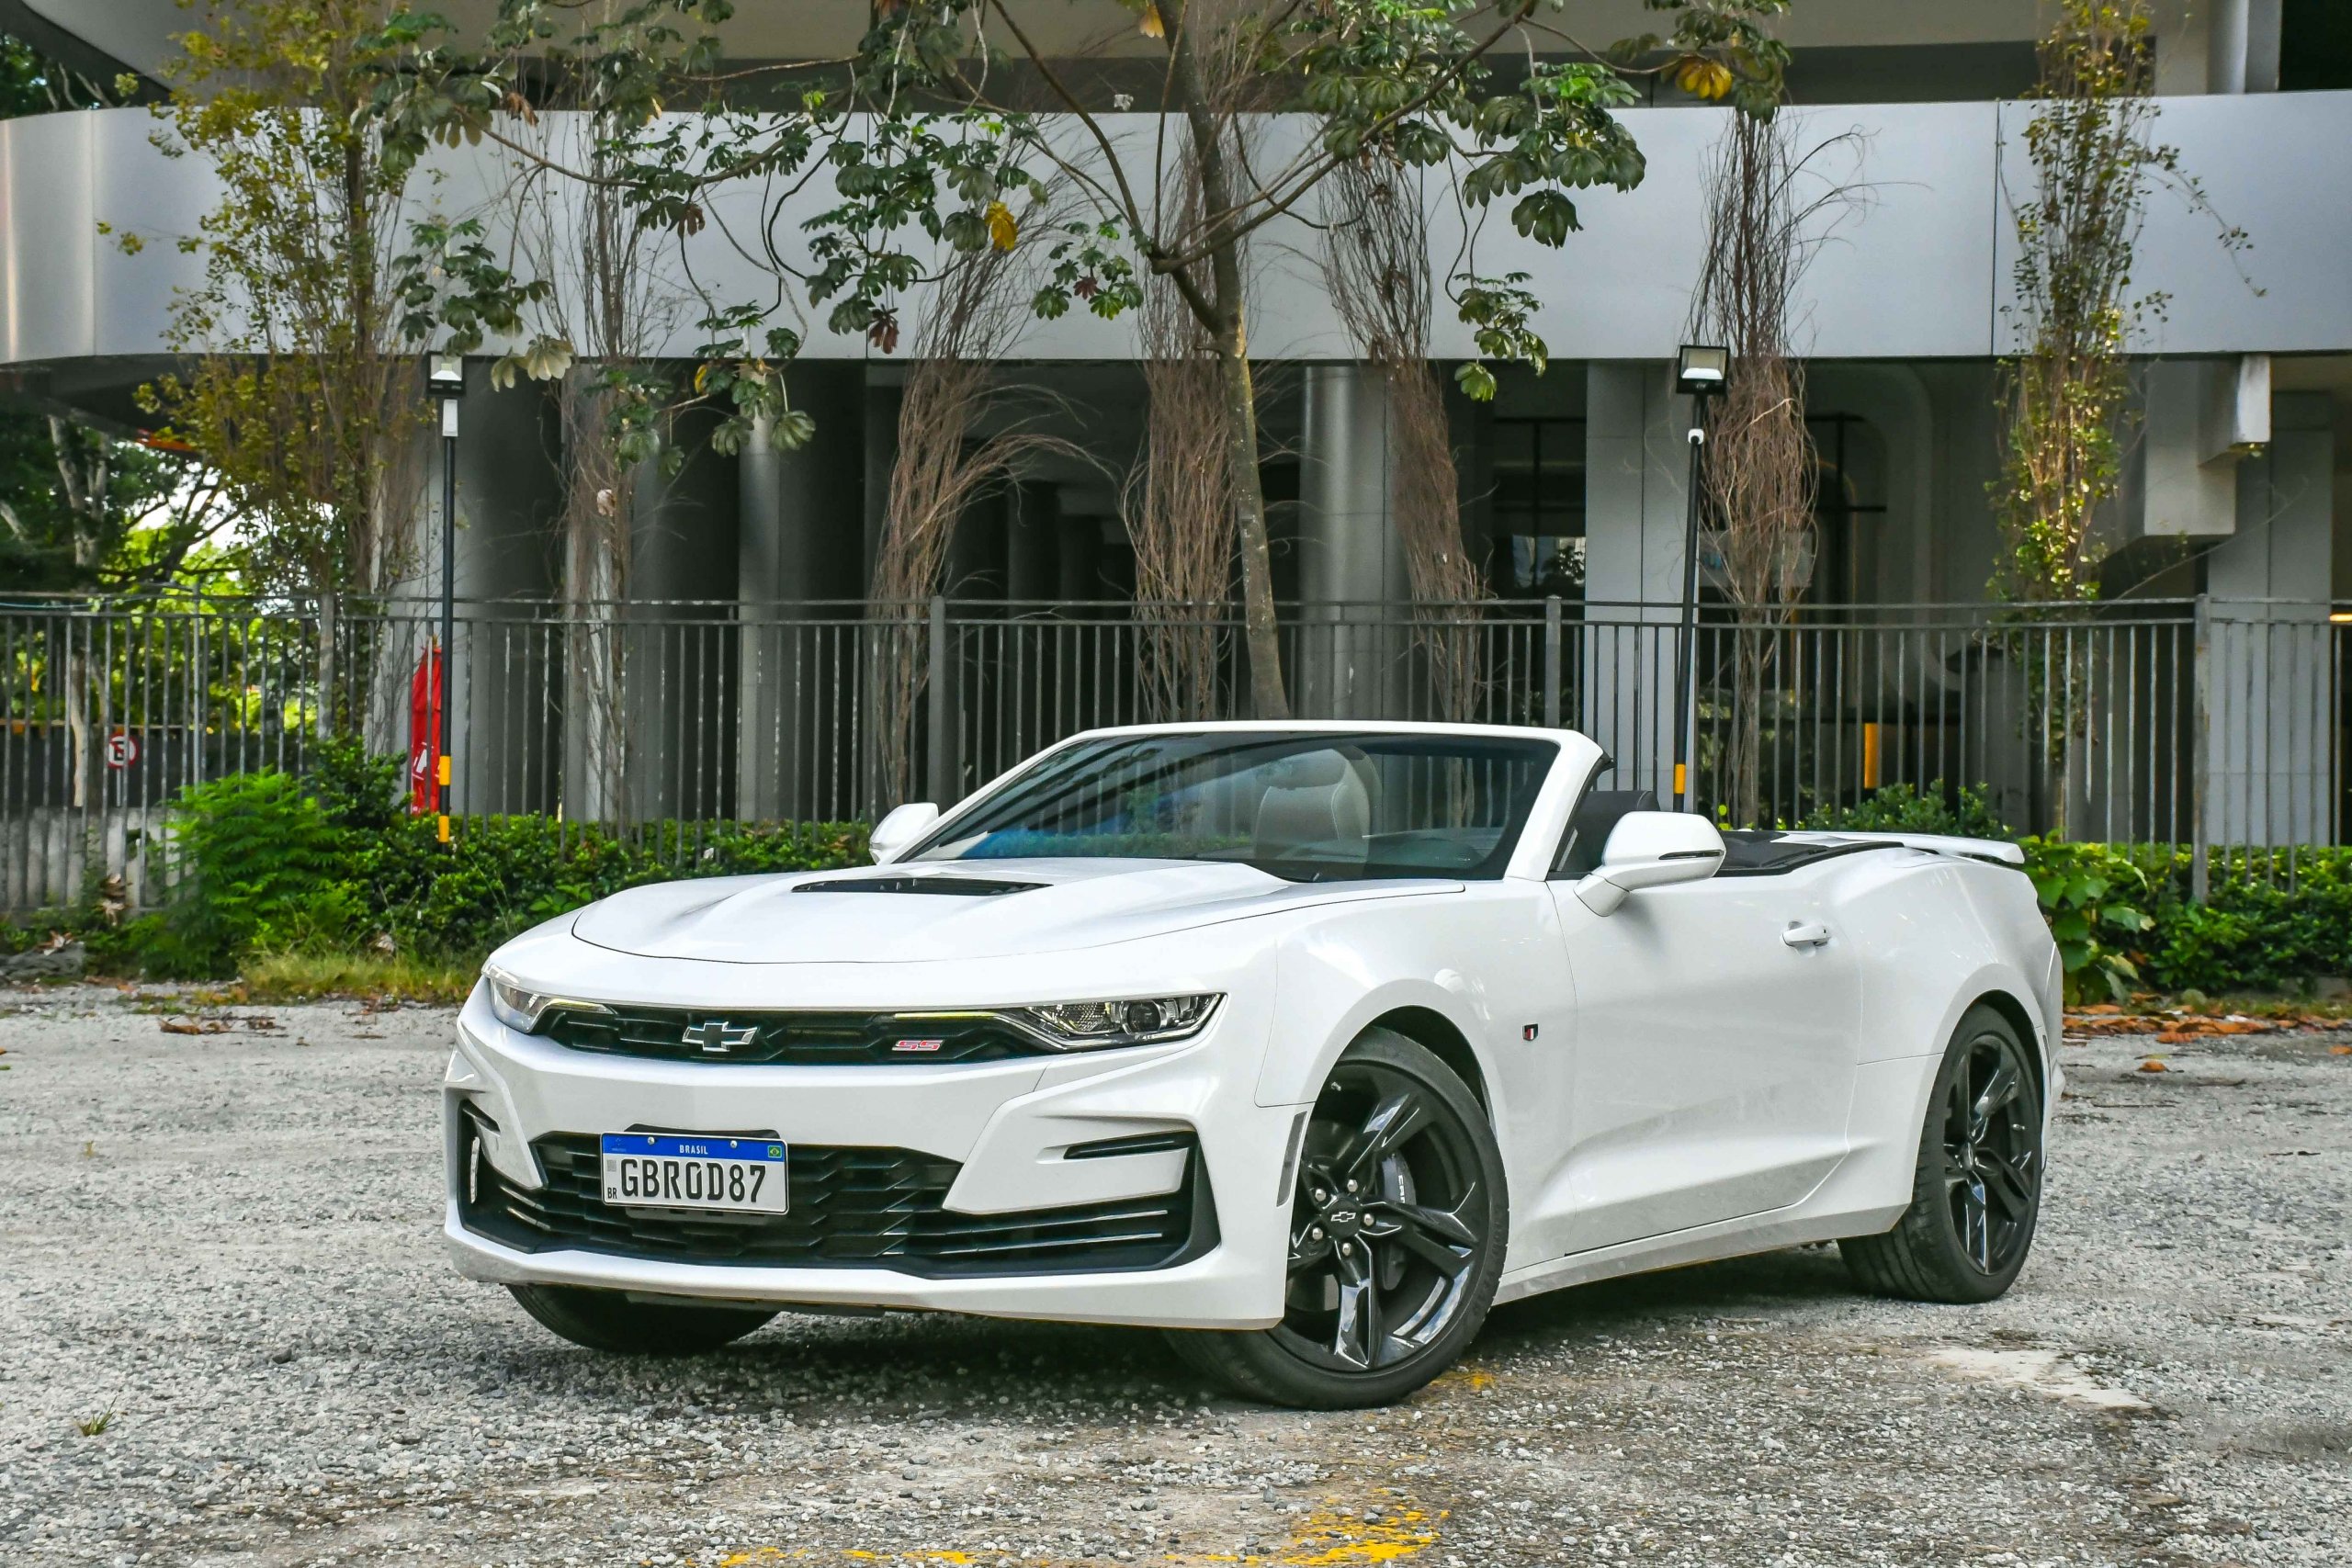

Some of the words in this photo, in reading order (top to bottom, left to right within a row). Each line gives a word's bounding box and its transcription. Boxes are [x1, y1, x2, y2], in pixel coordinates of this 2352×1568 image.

[891, 1040, 944, 1052] SS
[679, 1145, 708, 1155] BRASIL
[607, 1187, 617, 1200] BR
